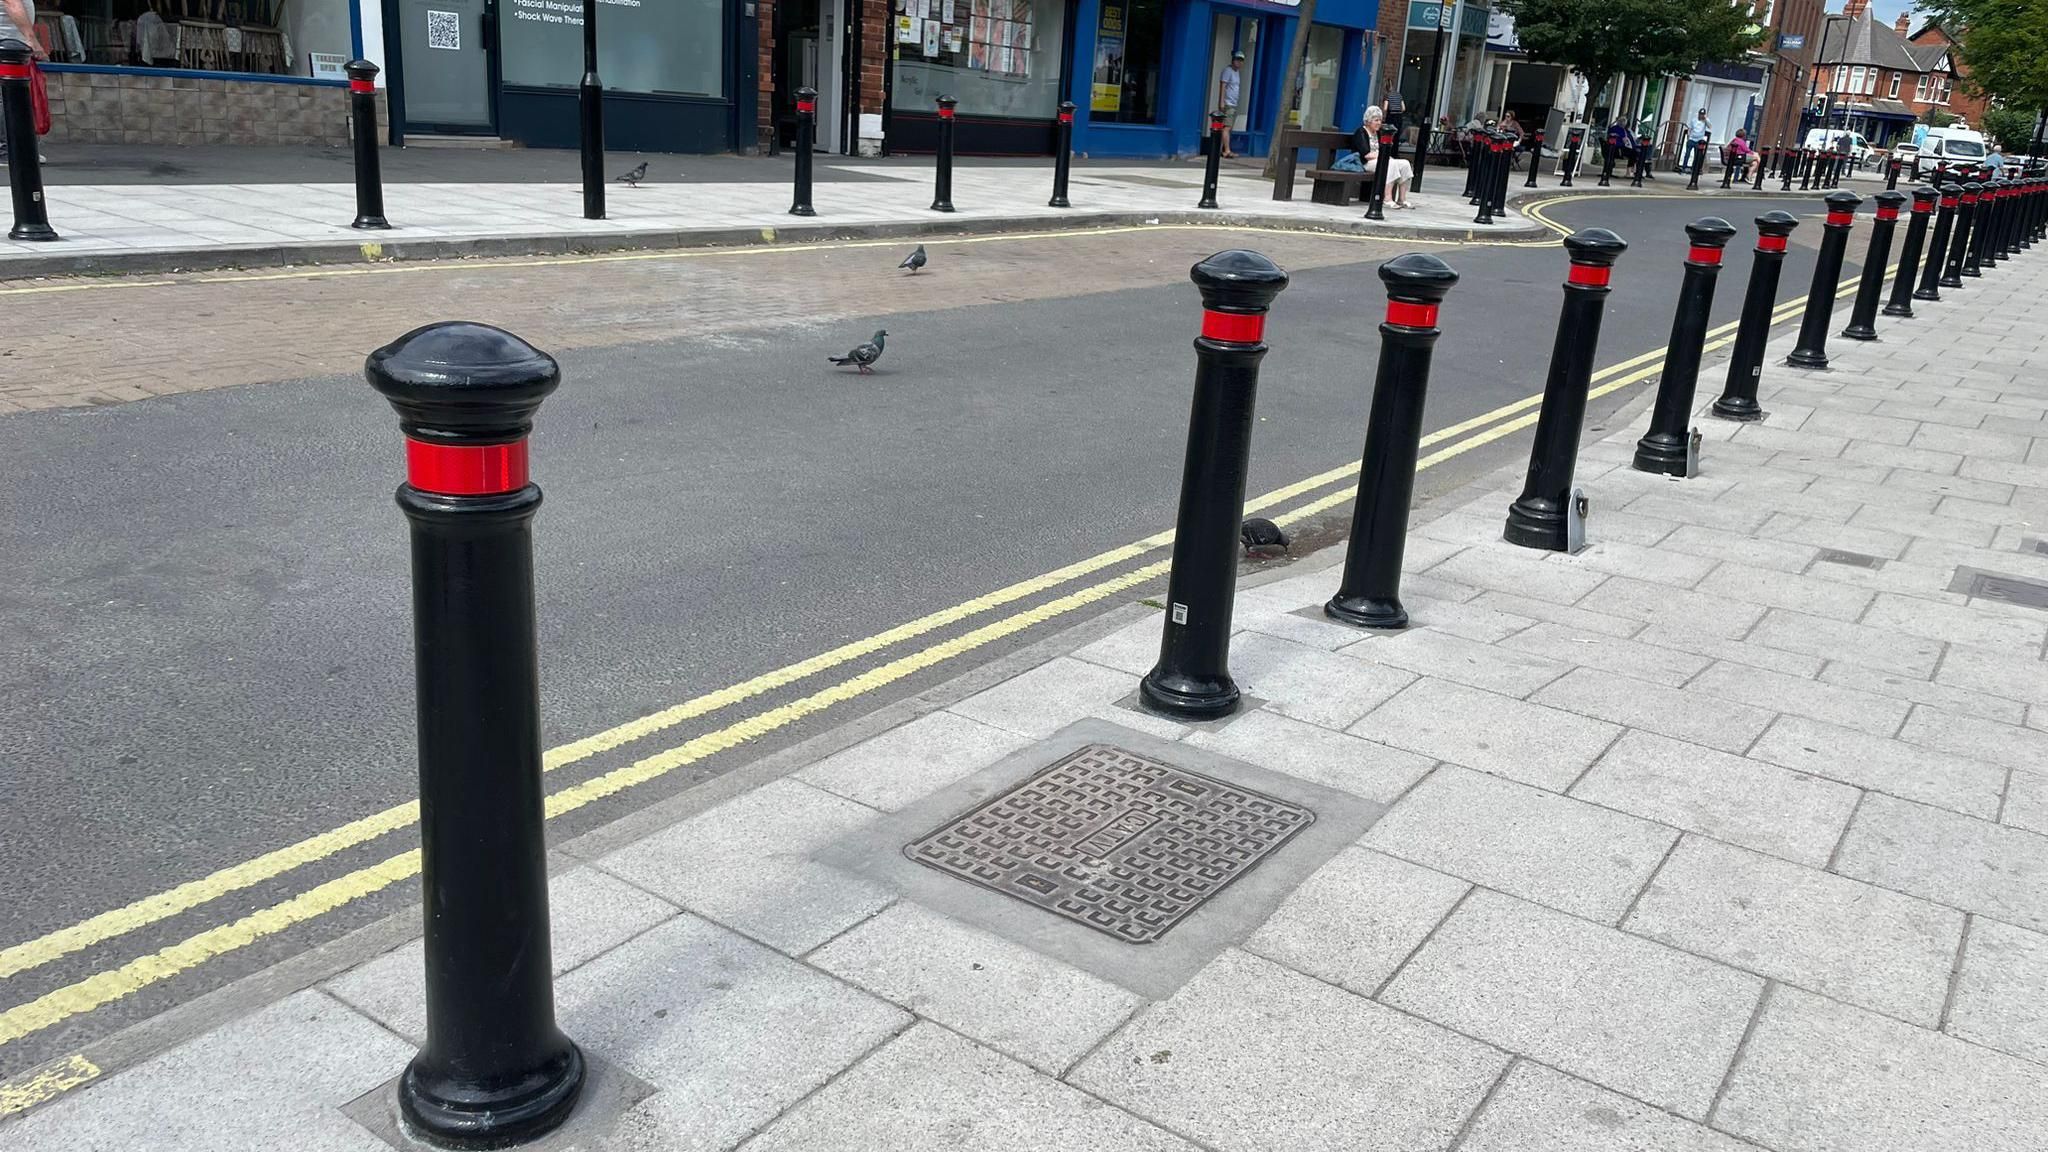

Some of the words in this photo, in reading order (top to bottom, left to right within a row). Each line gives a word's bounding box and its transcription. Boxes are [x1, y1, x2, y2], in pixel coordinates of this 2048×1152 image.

[518, 10, 541, 21] Shock
[542, 13, 563, 23] Wave
[564, 15, 584, 26] Thera
[1088, 815, 1147, 852] CATV
